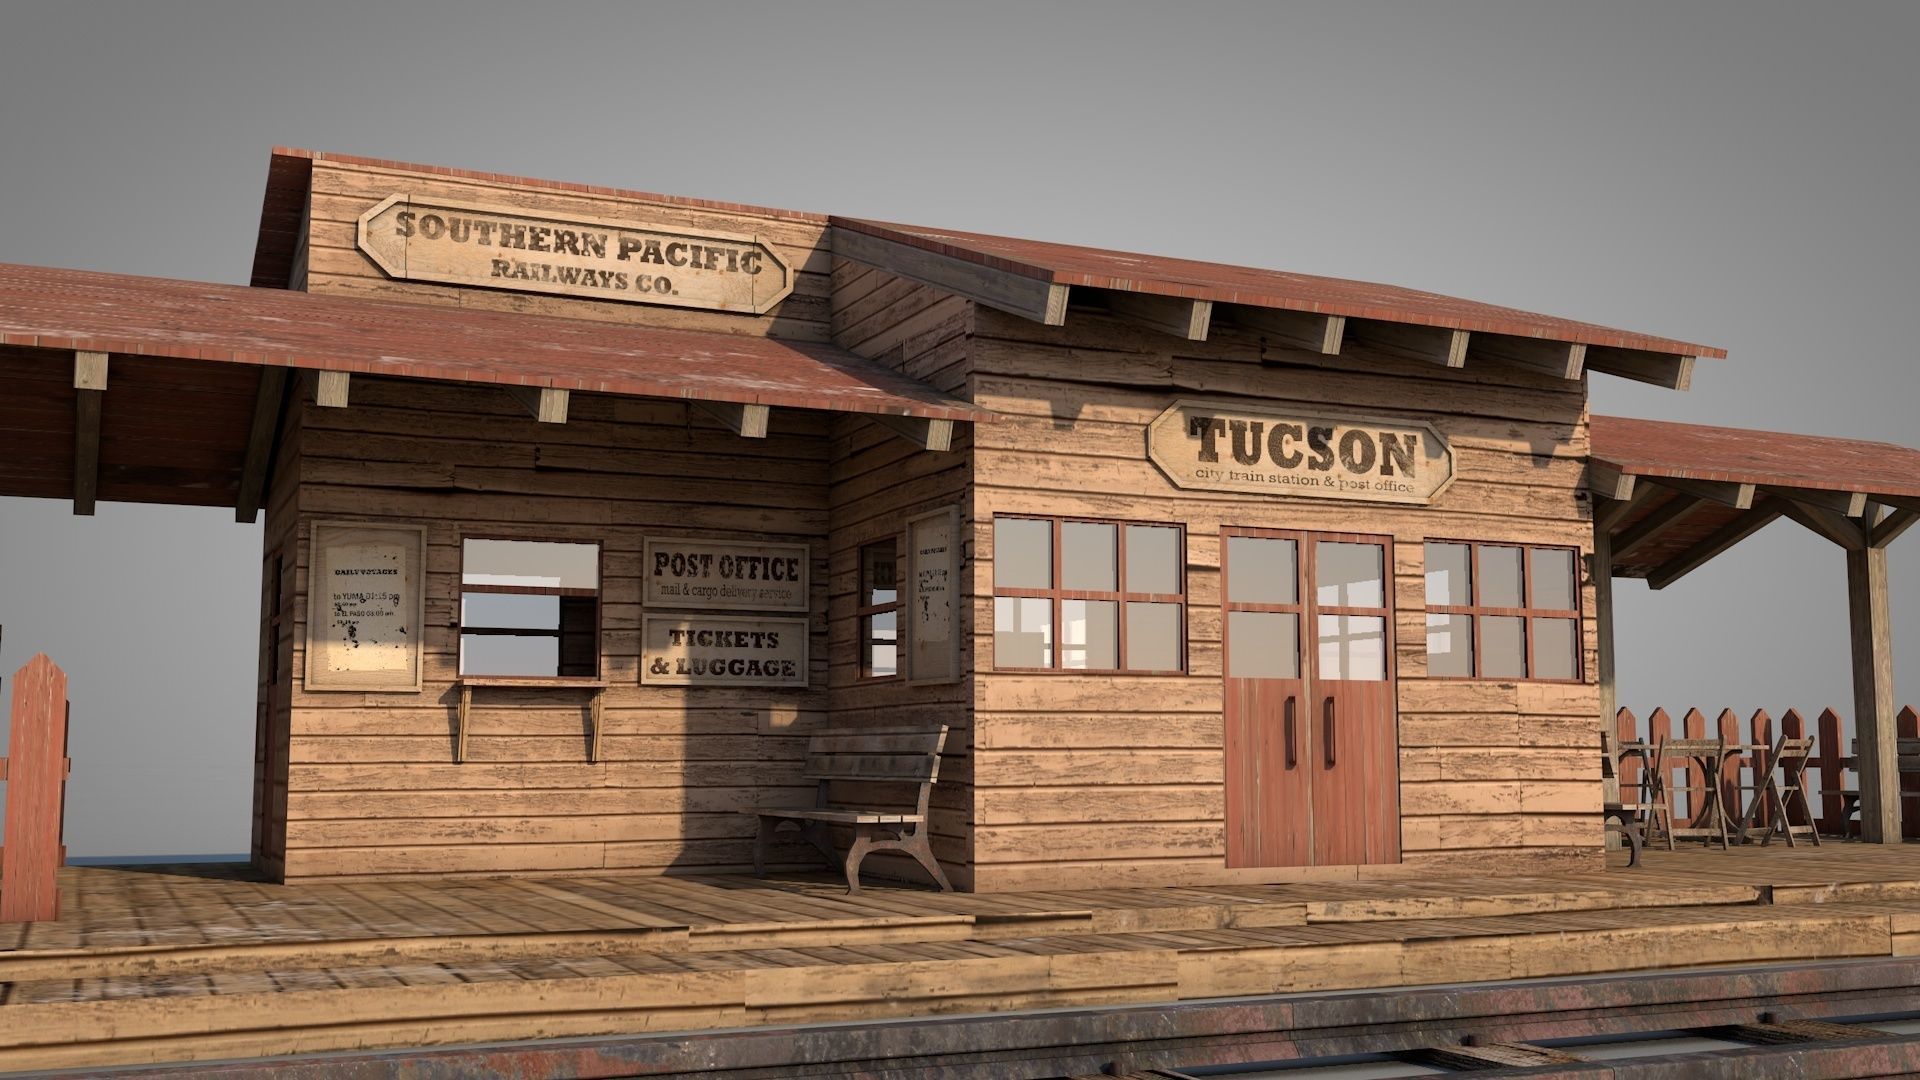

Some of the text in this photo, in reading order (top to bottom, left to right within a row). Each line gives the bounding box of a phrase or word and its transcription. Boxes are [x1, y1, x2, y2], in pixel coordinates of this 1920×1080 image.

[395, 210, 762, 276] SOUTHERN PACIFIC
[491, 258, 679, 296] RAILWAYS CO.
[1190, 415, 1417, 479] TUCSON
[1195, 468, 1415, 494] city train station & post office
[654, 551, 799, 582] POST OFFICE
[661, 582, 792, 601] mail & cargo delivery service
[669, 629, 779, 649] TICKETS
[650, 657, 796, 677] & LUGGAGE
